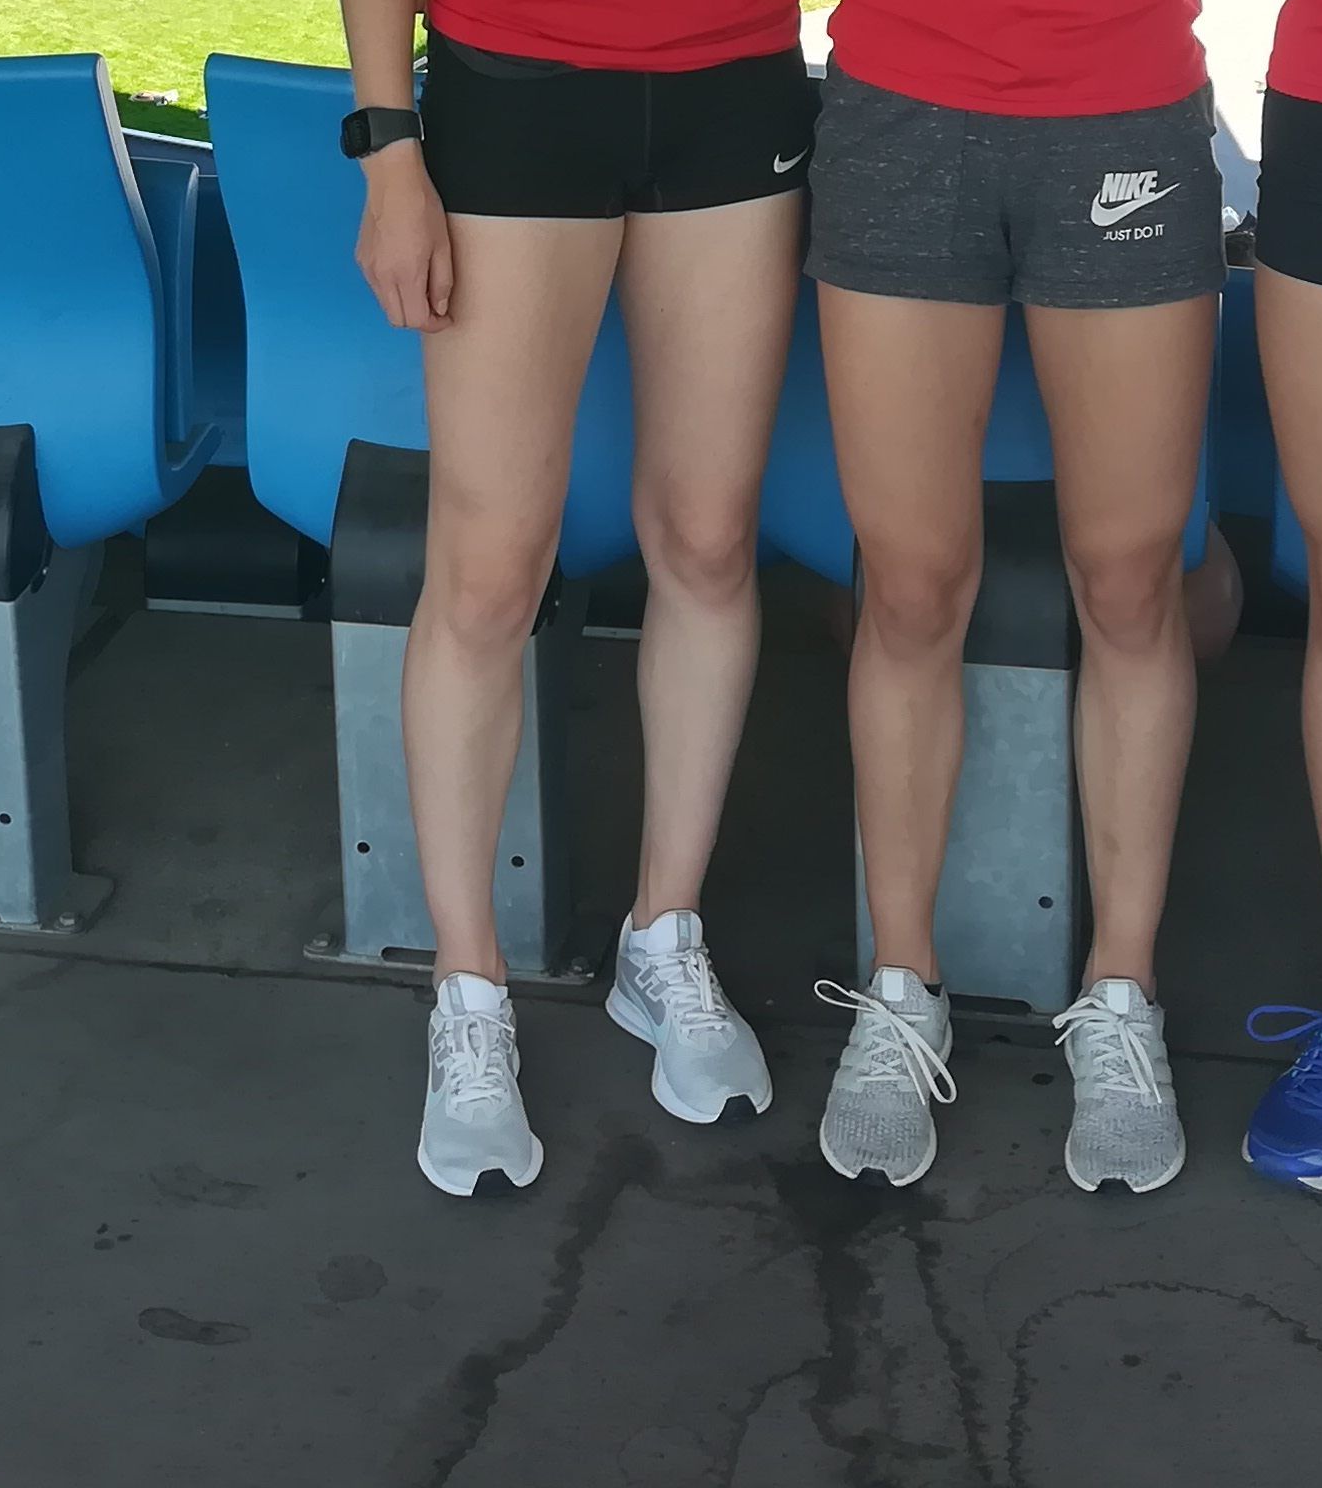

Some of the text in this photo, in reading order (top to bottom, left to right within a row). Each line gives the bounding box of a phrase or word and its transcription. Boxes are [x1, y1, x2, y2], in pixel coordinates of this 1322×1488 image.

[1100, 170, 1159, 204] NIKE
[1103, 224, 1165, 242] JUST DO IT
